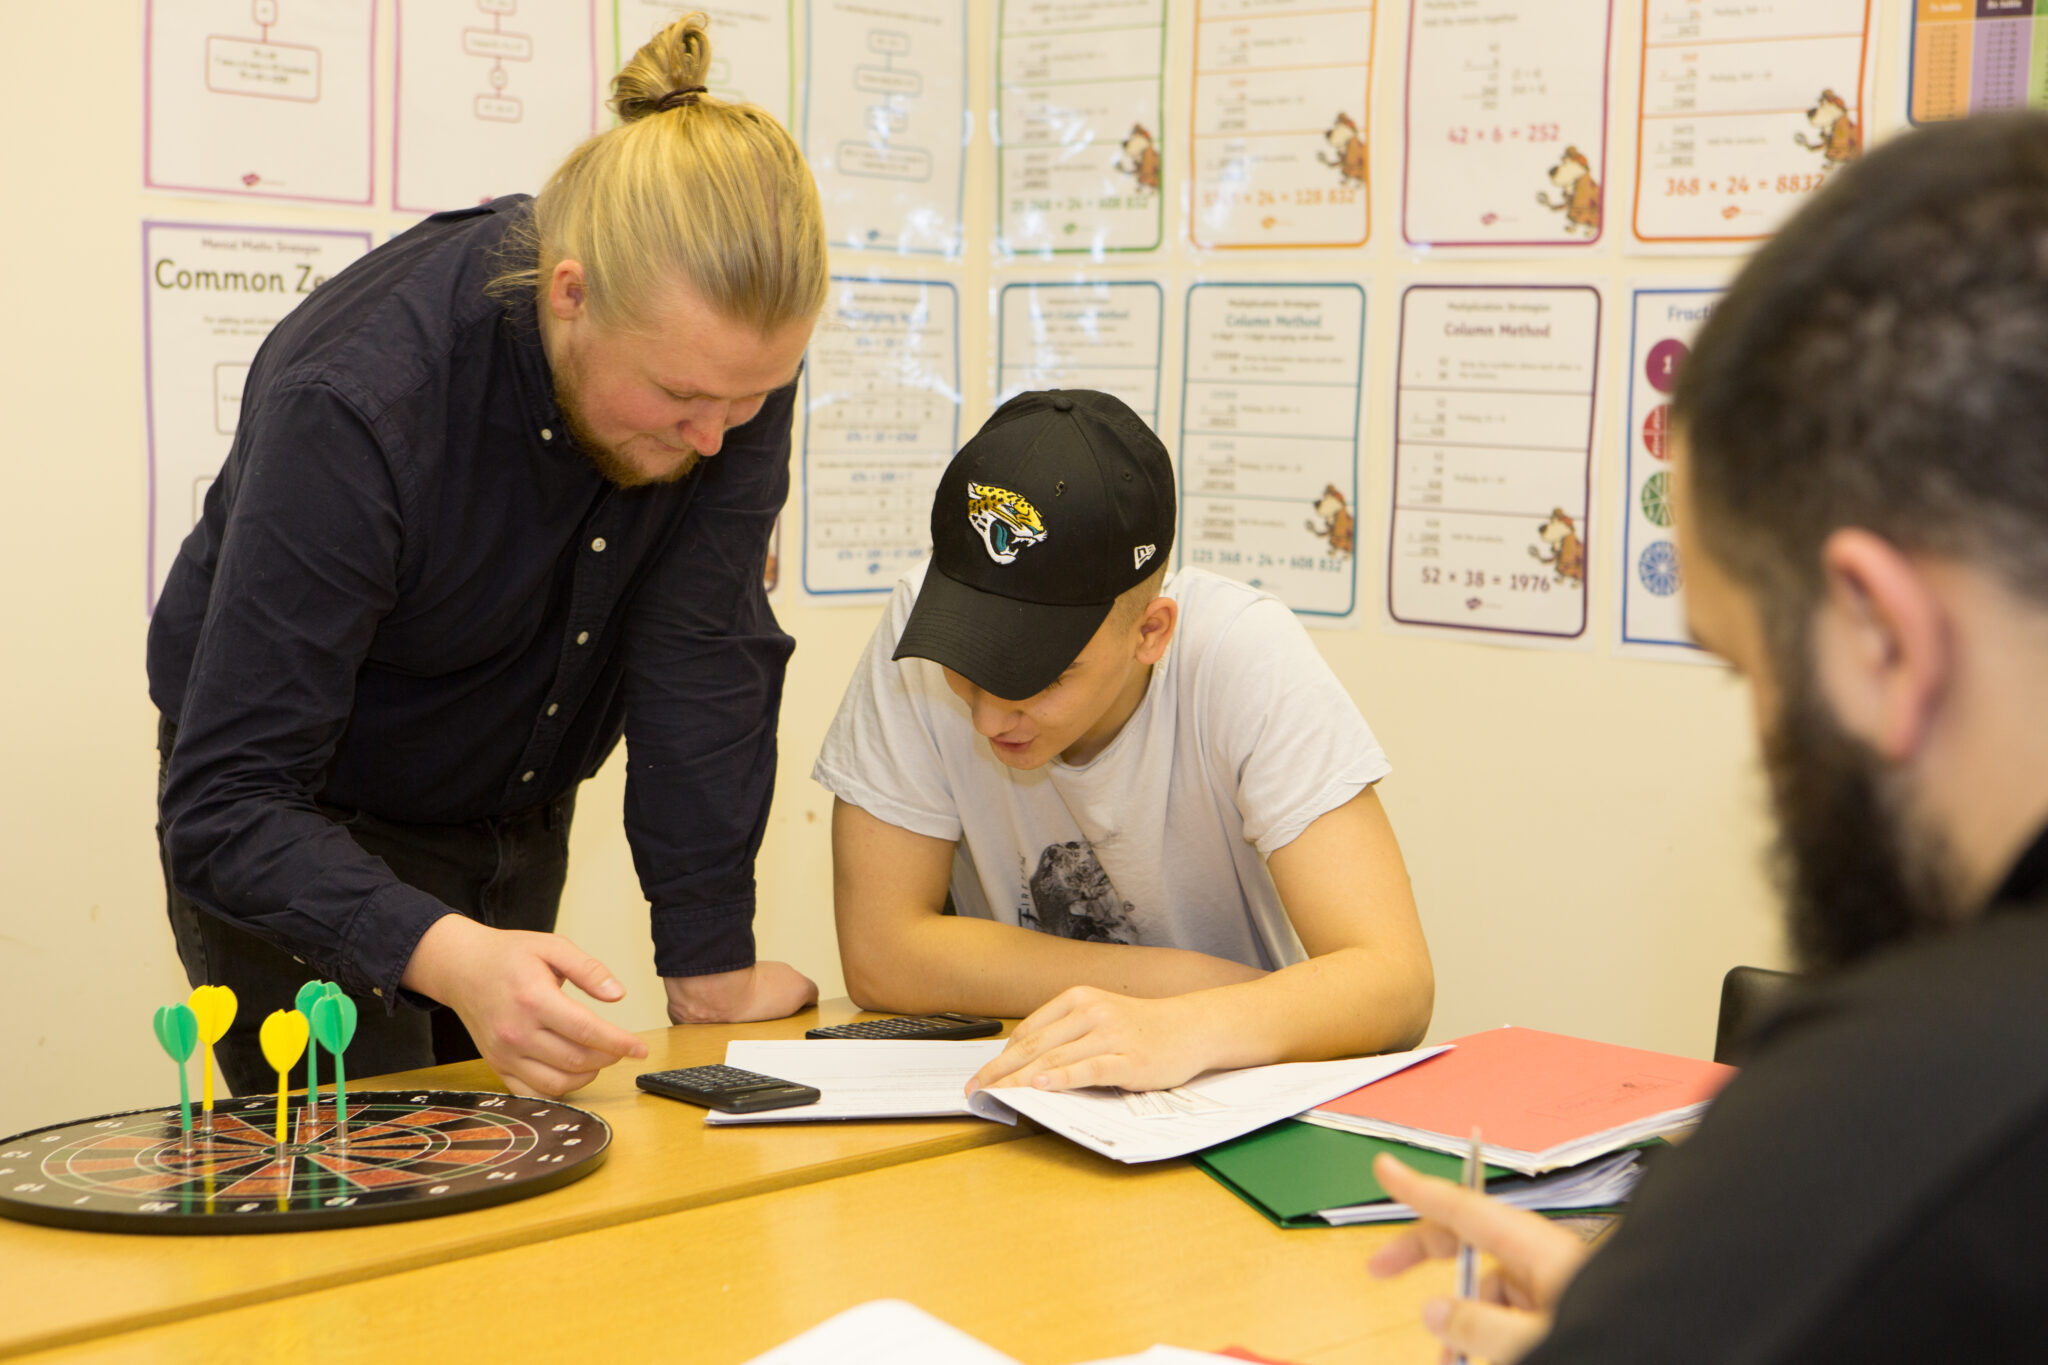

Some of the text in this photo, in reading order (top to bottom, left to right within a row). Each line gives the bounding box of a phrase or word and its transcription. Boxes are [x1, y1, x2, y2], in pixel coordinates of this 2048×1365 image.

[1447, 125, 1468, 145] 42
[1527, 122, 1560, 143] 252
[1665, 177, 1701, 196] 368
[1726, 176, 1749, 195] 24
[1776, 174, 1826, 194] 8832
[155, 258, 331, 294] Common Ze
[1226, 314, 1322, 329] Column Method
[1444, 322, 1551, 338] Column Method
[1662, 354, 1672, 375] 1
[1258, 552, 1274, 567] 24
[1421, 566, 1441, 584] 52
[1465, 570, 1485, 588] 38
[1510, 574, 1551, 592] 1976
[537, 1153, 565, 1163] 11
[486, 1171, 517, 1180] 14
[138, 1201, 178, 1212] 20
